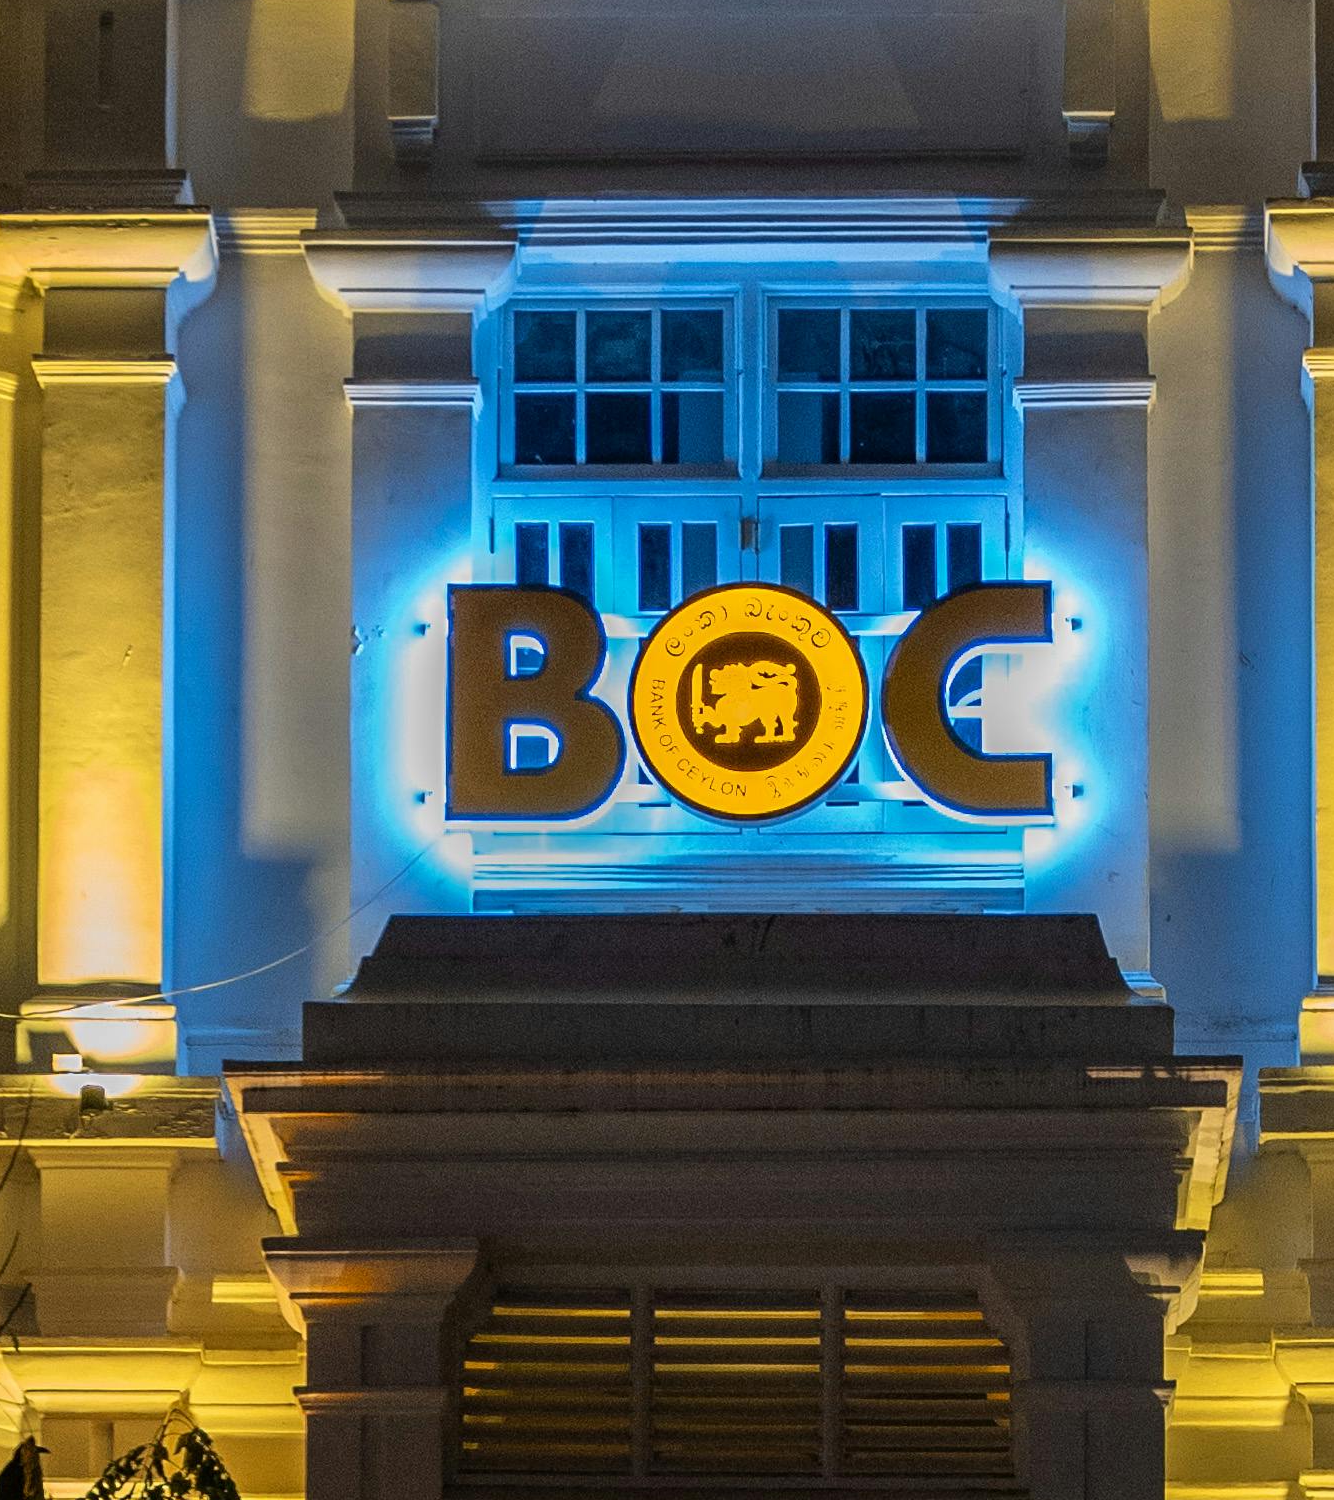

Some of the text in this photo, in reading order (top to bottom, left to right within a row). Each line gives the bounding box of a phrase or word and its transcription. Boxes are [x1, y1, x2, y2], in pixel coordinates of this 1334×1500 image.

[446, 580, 1054, 822] BOC
[649, 679, 747, 798] BANK OF CEYLON
